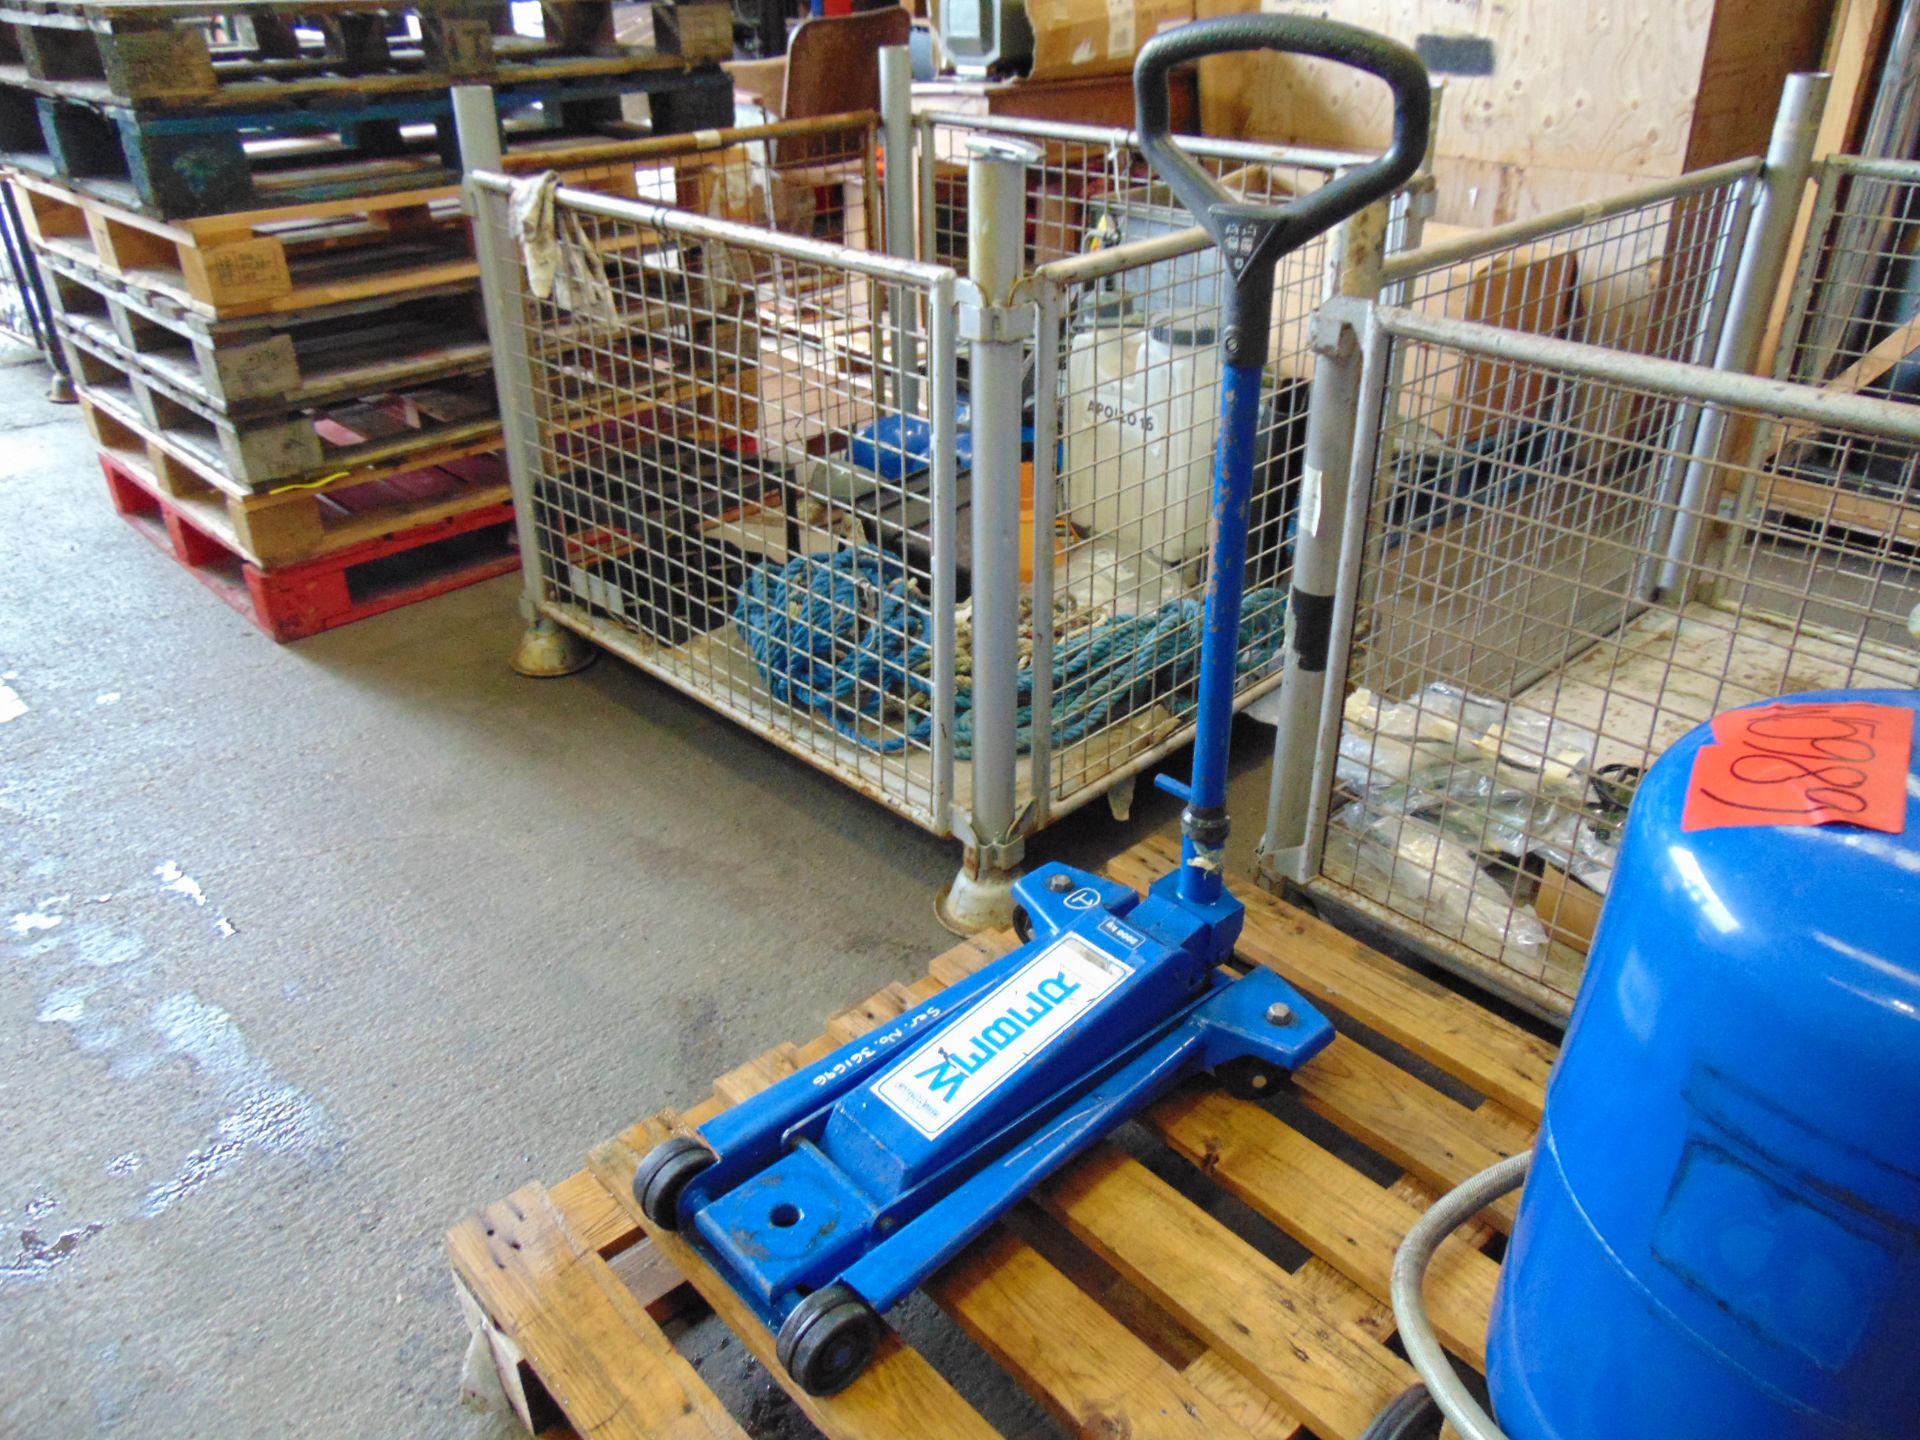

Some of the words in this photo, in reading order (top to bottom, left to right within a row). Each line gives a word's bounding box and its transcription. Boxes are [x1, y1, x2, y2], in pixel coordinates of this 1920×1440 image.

[904, 1006, 940, 1028] Ser.
[874, 1028, 902, 1045] No.
[915, 970, 1081, 1103] WEBER
[813, 1046, 876, 1086] 361696
